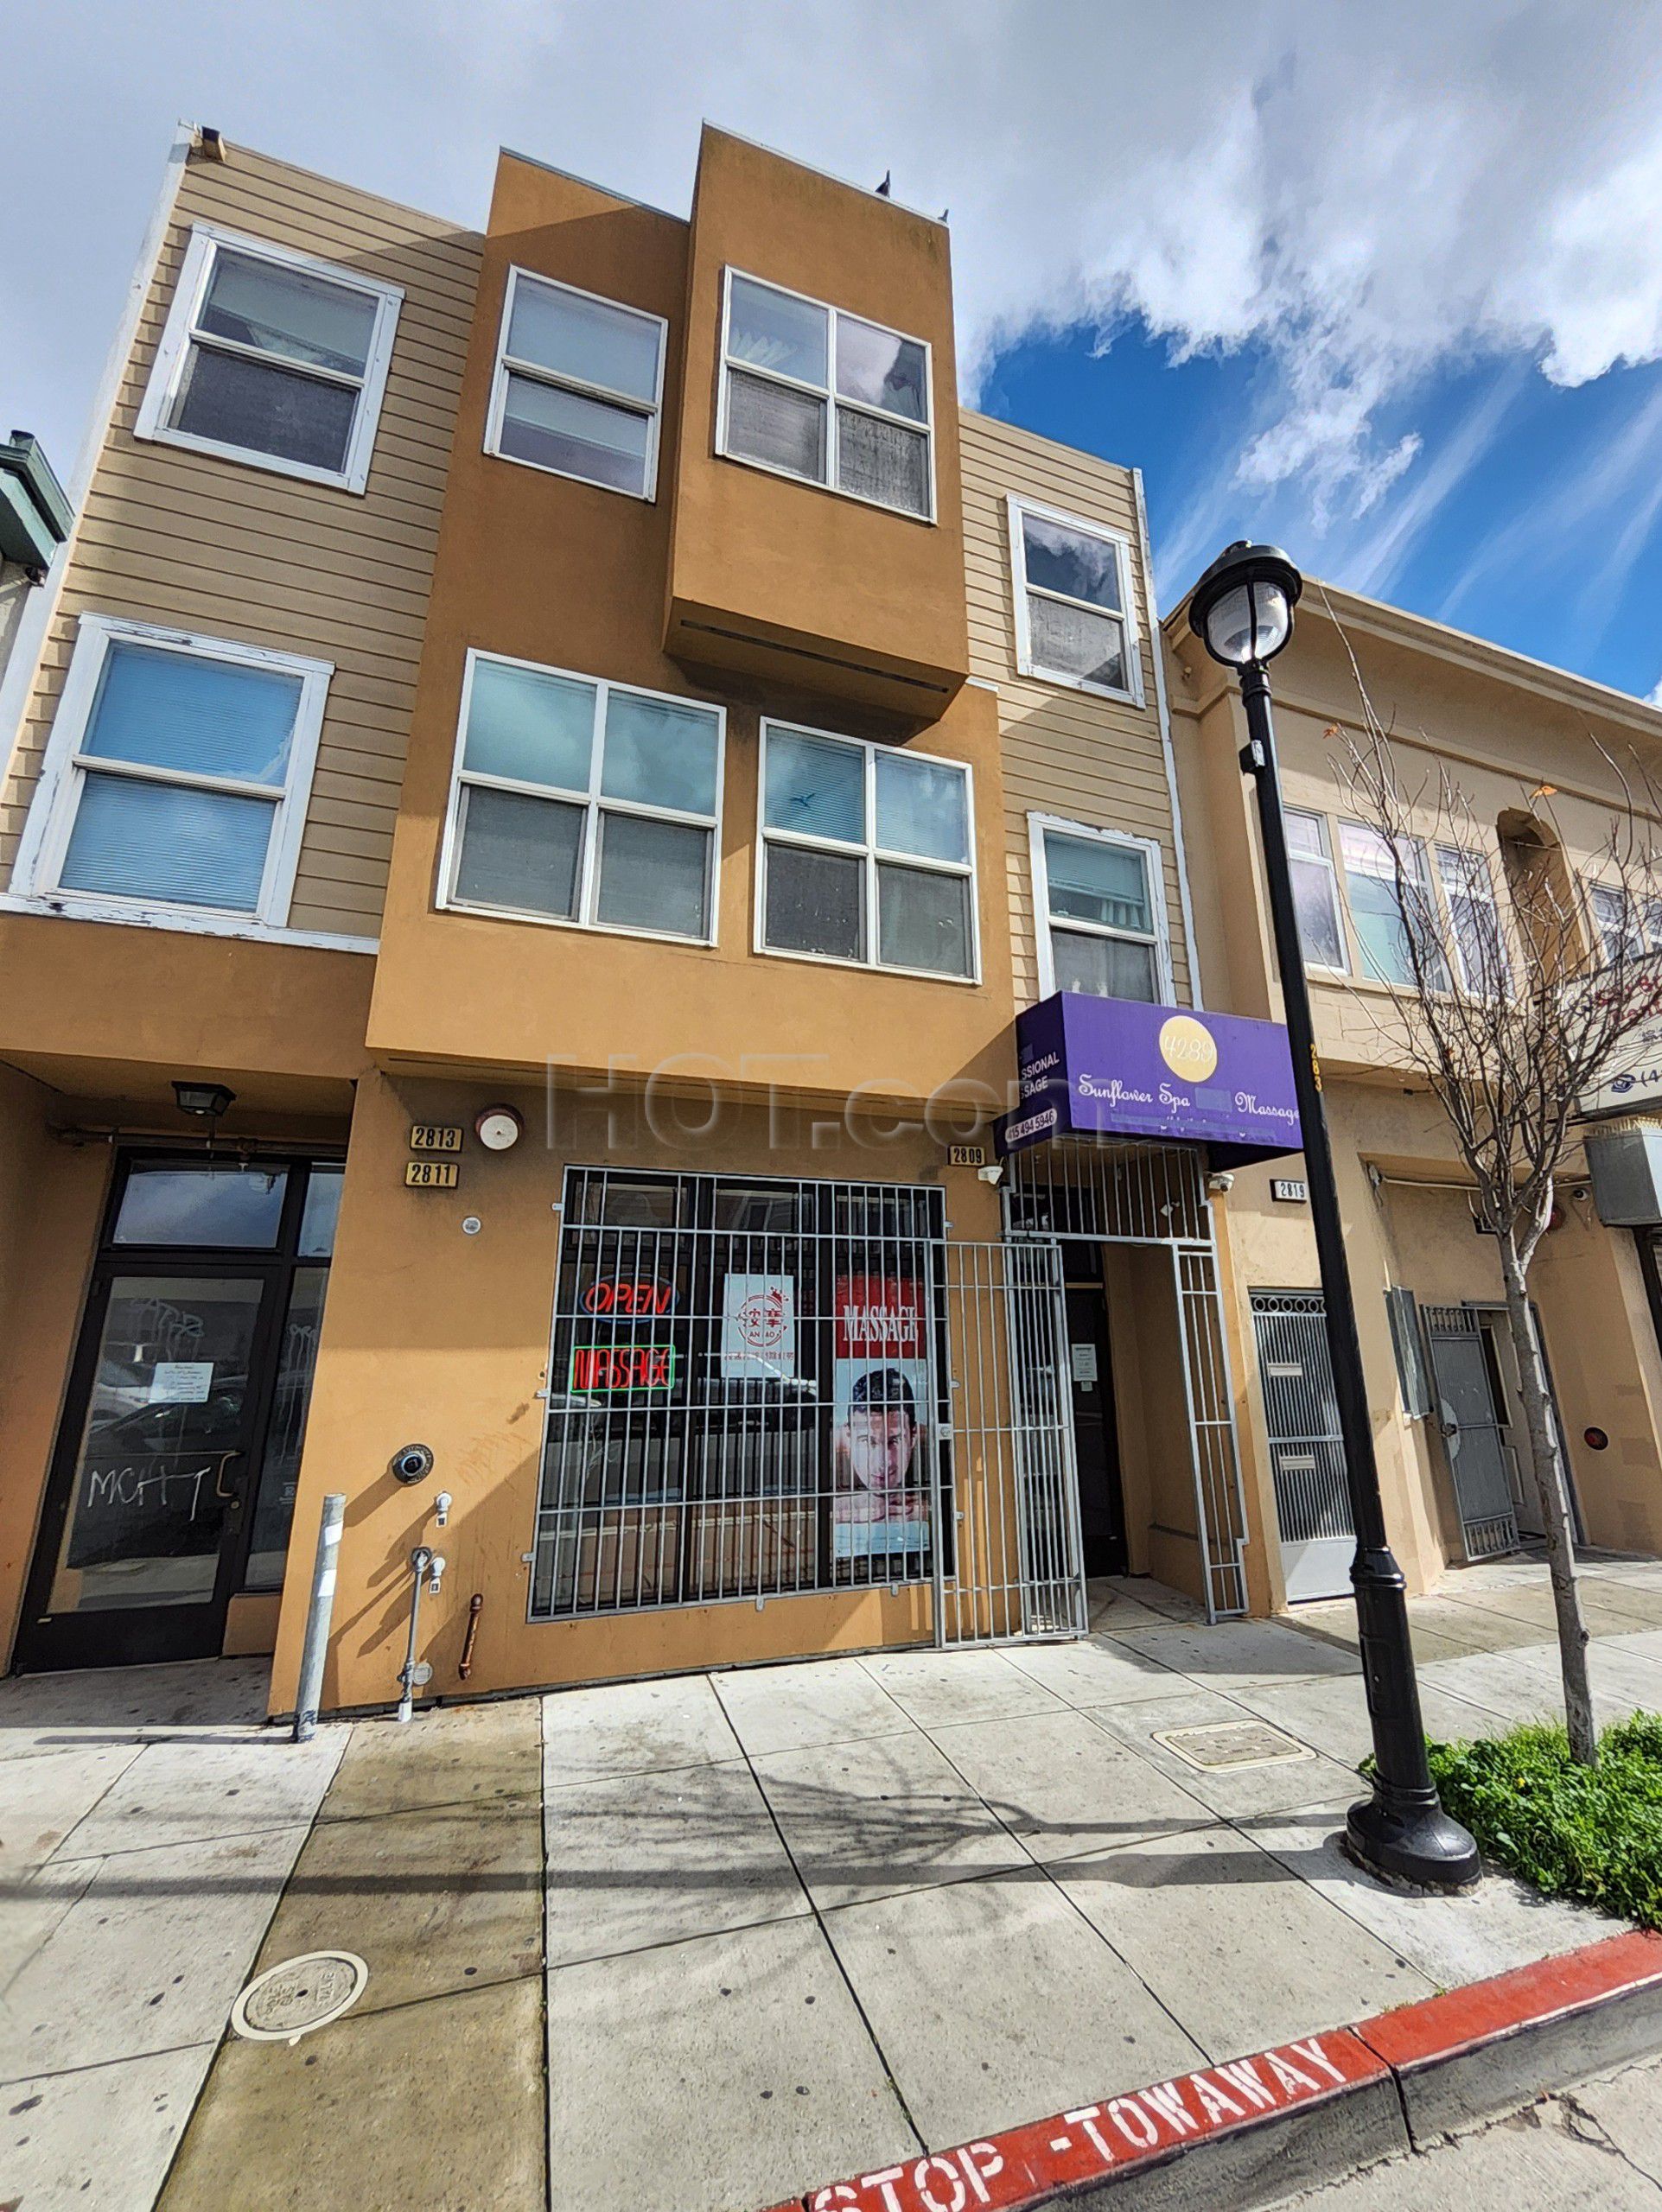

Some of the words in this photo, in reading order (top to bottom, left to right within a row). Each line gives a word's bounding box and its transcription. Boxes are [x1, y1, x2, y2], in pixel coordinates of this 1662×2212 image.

[1310, 1044, 1323, 1092] 283
[1078, 1074, 1154, 1108] Sunflower
[1158, 1082, 1191, 1114] Spa
[415, 1127, 455, 1147] 2813
[953, 1147, 982, 1164] 2809
[411, 1164, 450, 1185] 2811
[1280, 1181, 1305, 1198] 2819
[585, 1282, 672, 1314] OPEN
[843, 1304, 918, 1343] MASSAGE
[573, 1348, 671, 1389] MASSAGE
